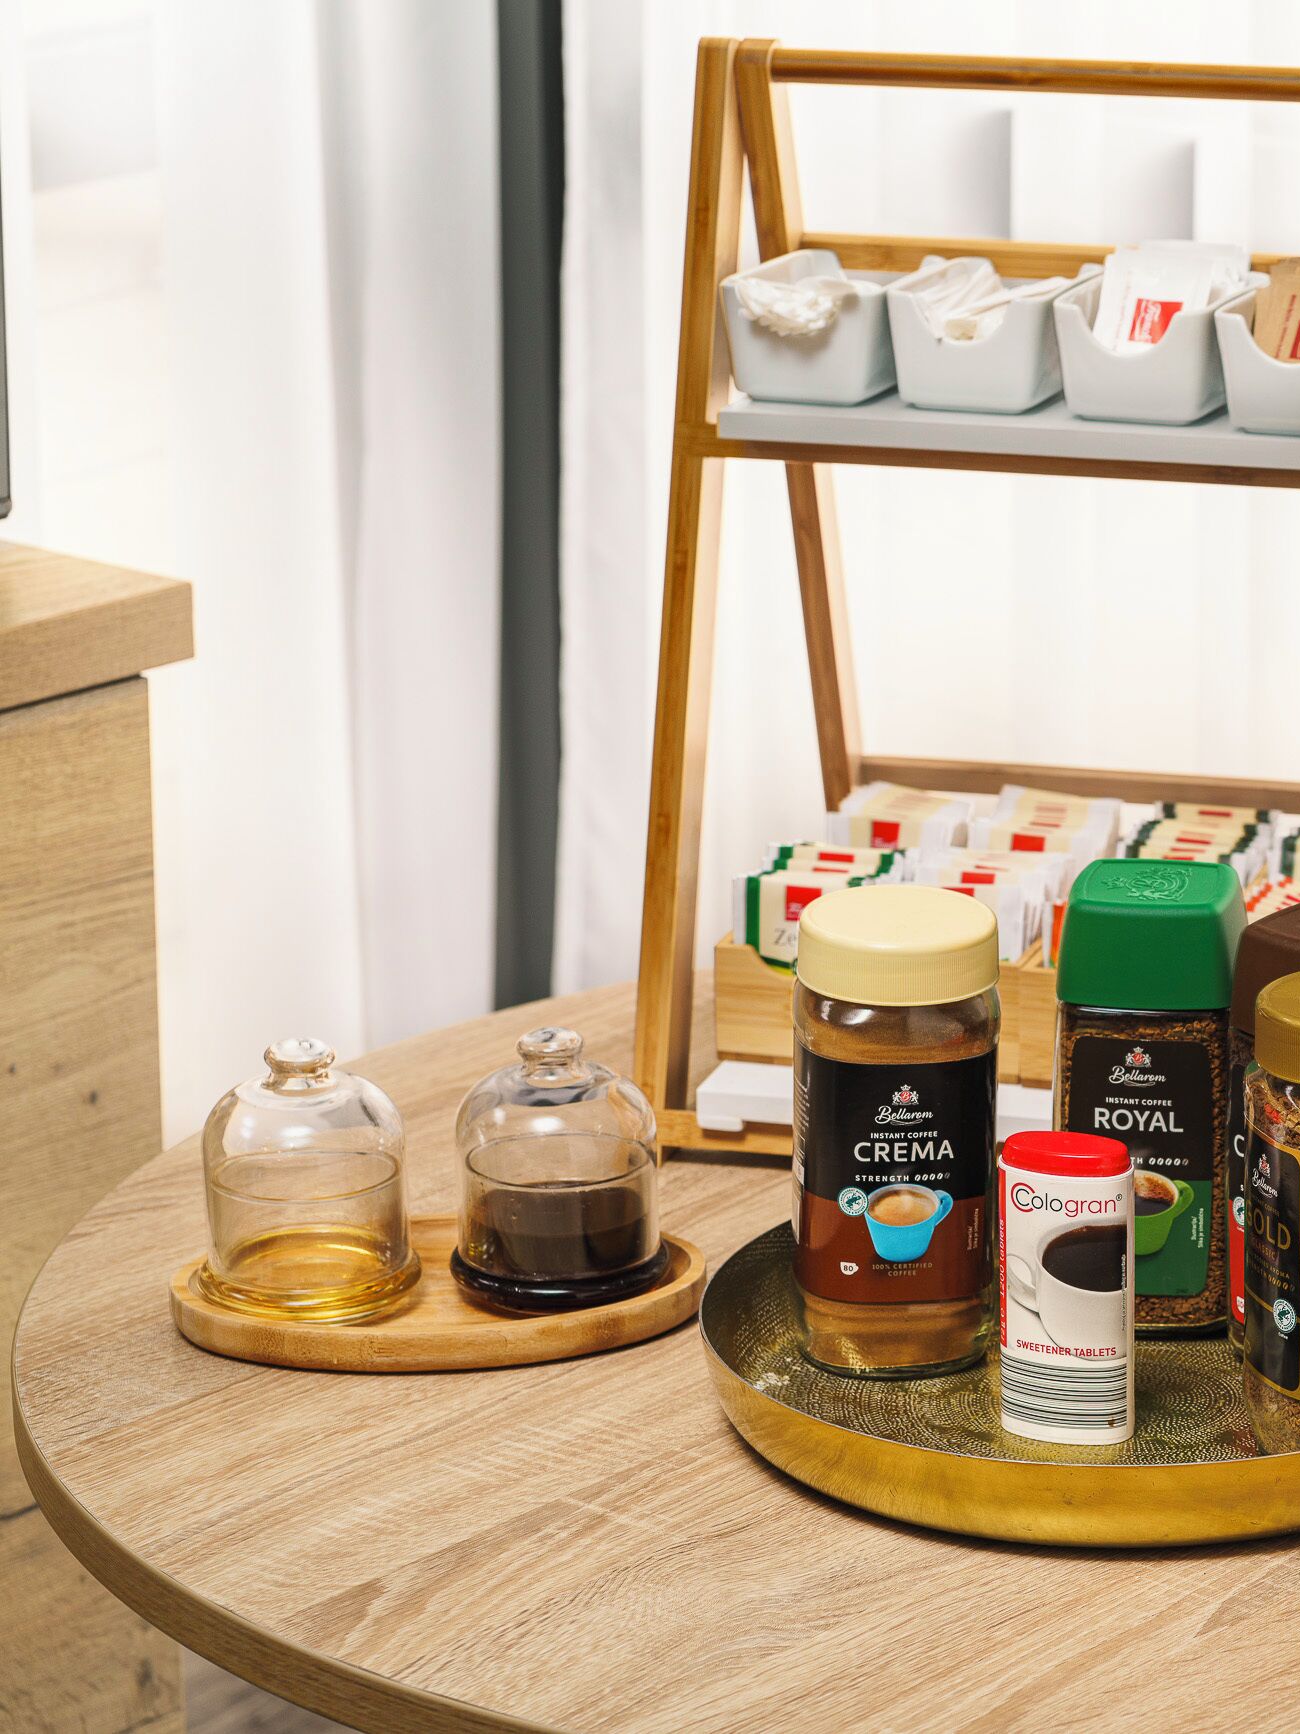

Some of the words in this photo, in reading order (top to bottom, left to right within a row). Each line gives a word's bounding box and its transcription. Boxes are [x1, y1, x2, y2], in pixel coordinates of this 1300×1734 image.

[1109, 1065, 1166, 1087] Bellarom
[1105, 1097, 1139, 1105] INSTANT
[1141, 1099, 1172, 1107] COFFEE
[875, 1105, 933, 1126] Bellarom
[1094, 1107, 1184, 1133] ROYAL
[907, 1130, 938, 1139] COFFEE
[853, 1139, 955, 1163] CREMA
[855, 1174, 910, 1182] STRENGTH
[892, 1262, 933, 1270] CERTIFIED
[1016, 1339, 1071, 1356] SWEETENER
[1073, 1347, 1117, 1357] TABLETS
